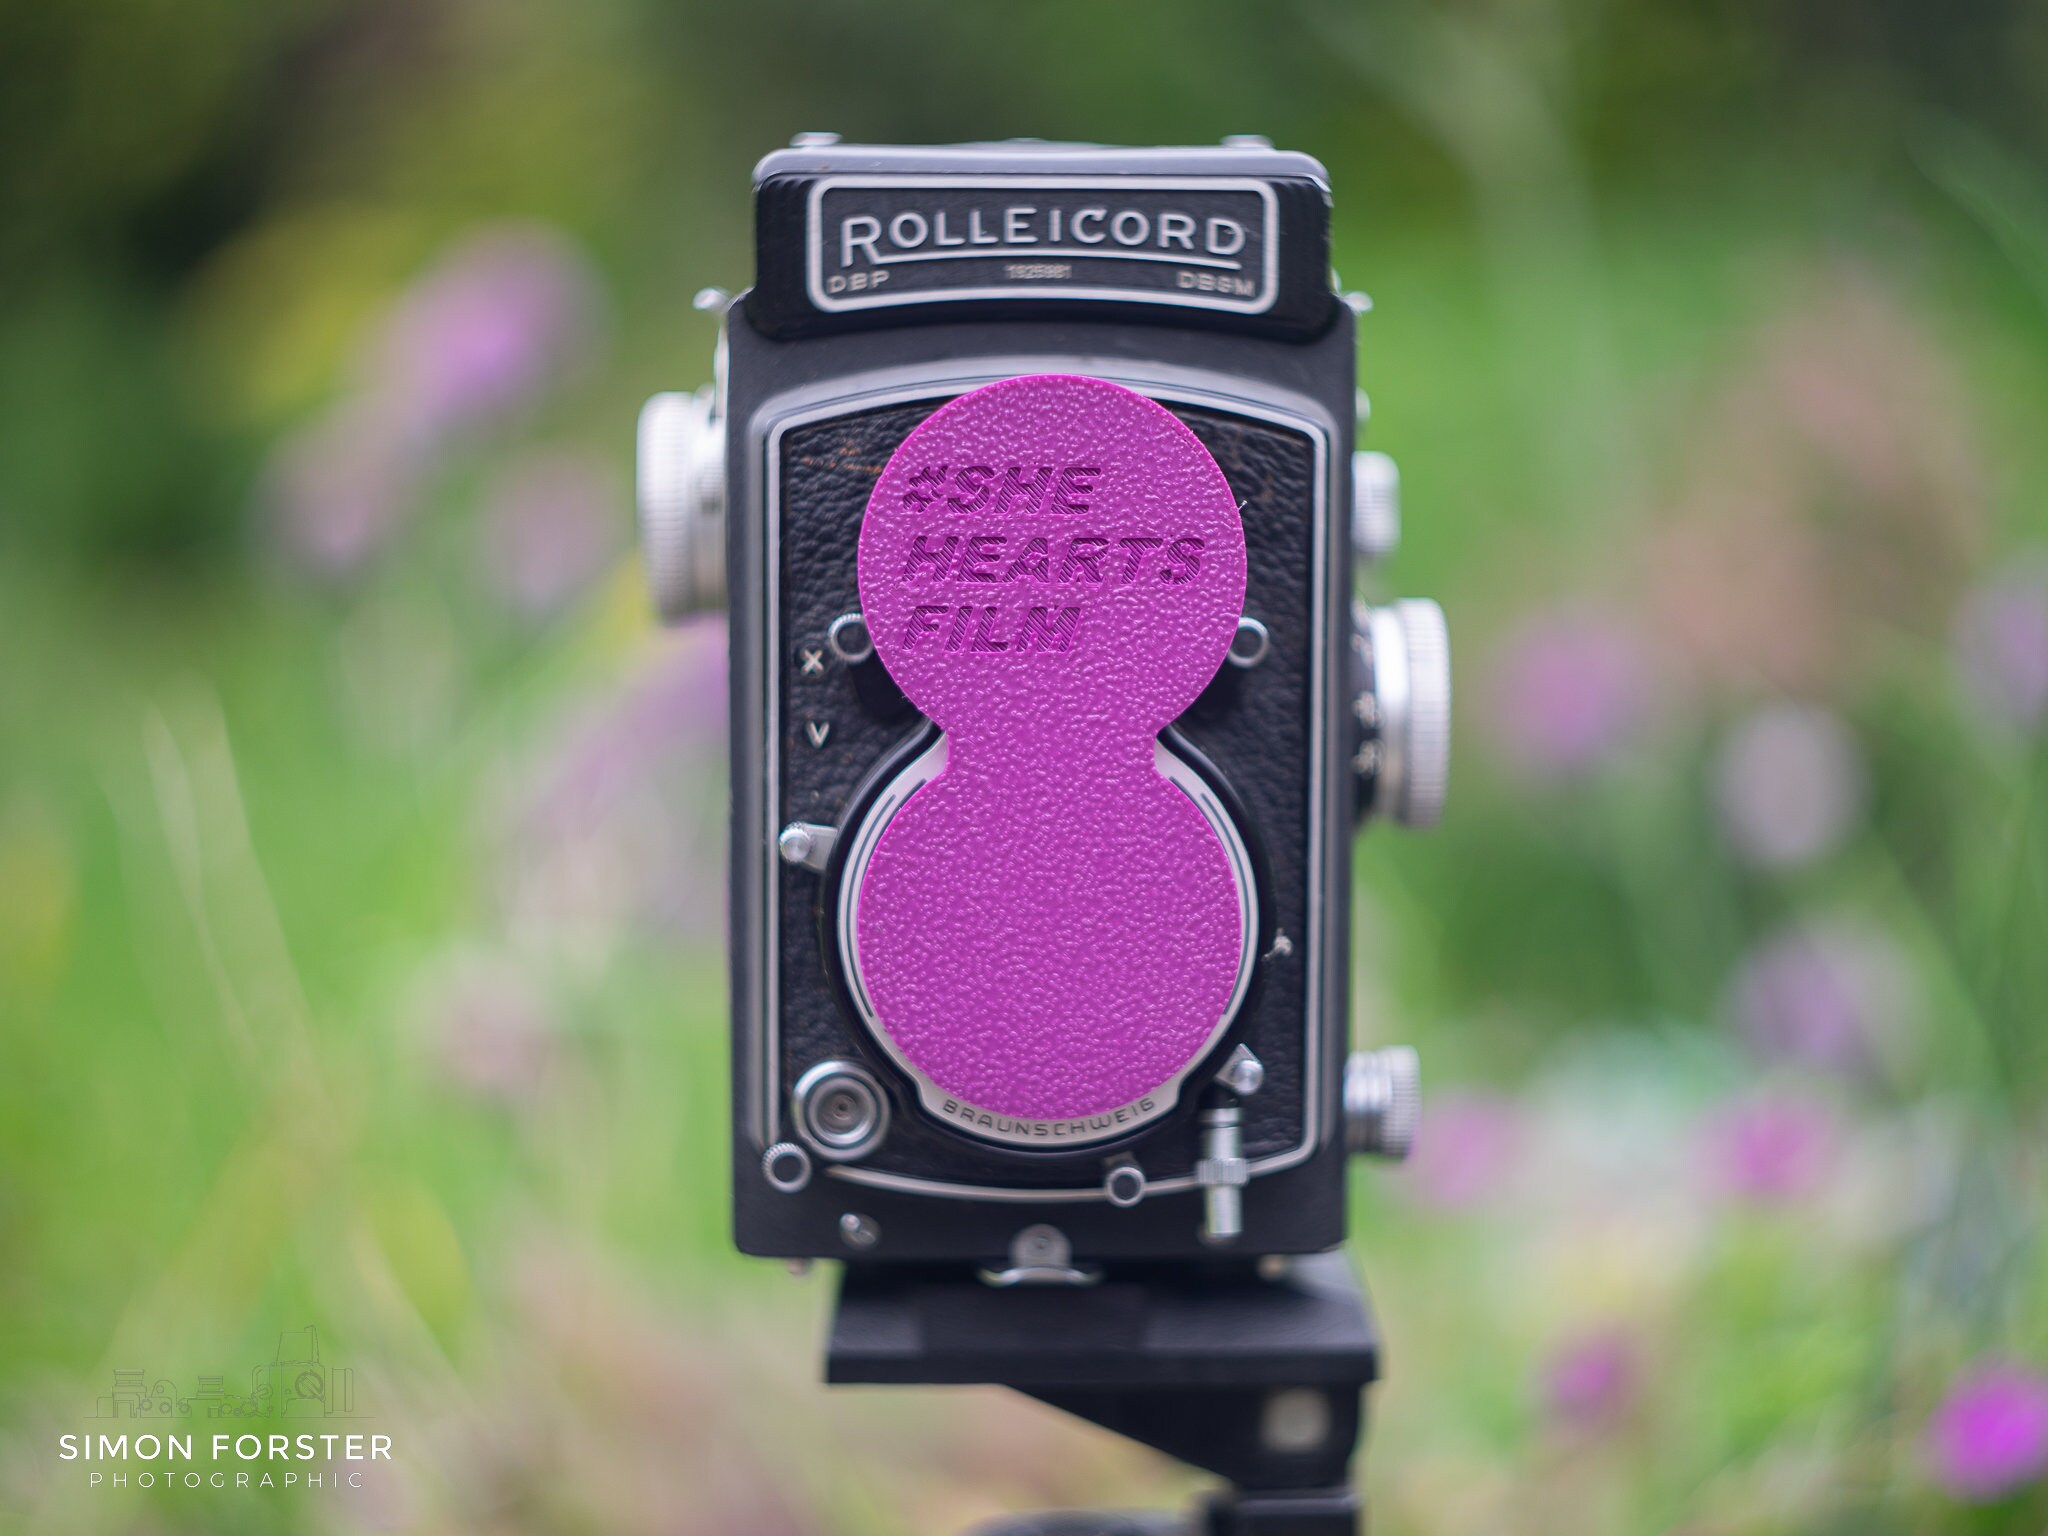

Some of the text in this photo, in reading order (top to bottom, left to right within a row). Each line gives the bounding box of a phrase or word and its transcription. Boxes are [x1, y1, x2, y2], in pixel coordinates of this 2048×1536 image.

[841, 208, 1245, 268] ROLLEICORD
[827, 270, 890, 294] DBP
[902, 465, 1102, 514] #SHE
[902, 535, 1206, 585] HEARTS
[902, 605, 1082, 653] FILM
[943, 1098, 1155, 1136] BRAUNSCHWEIG
